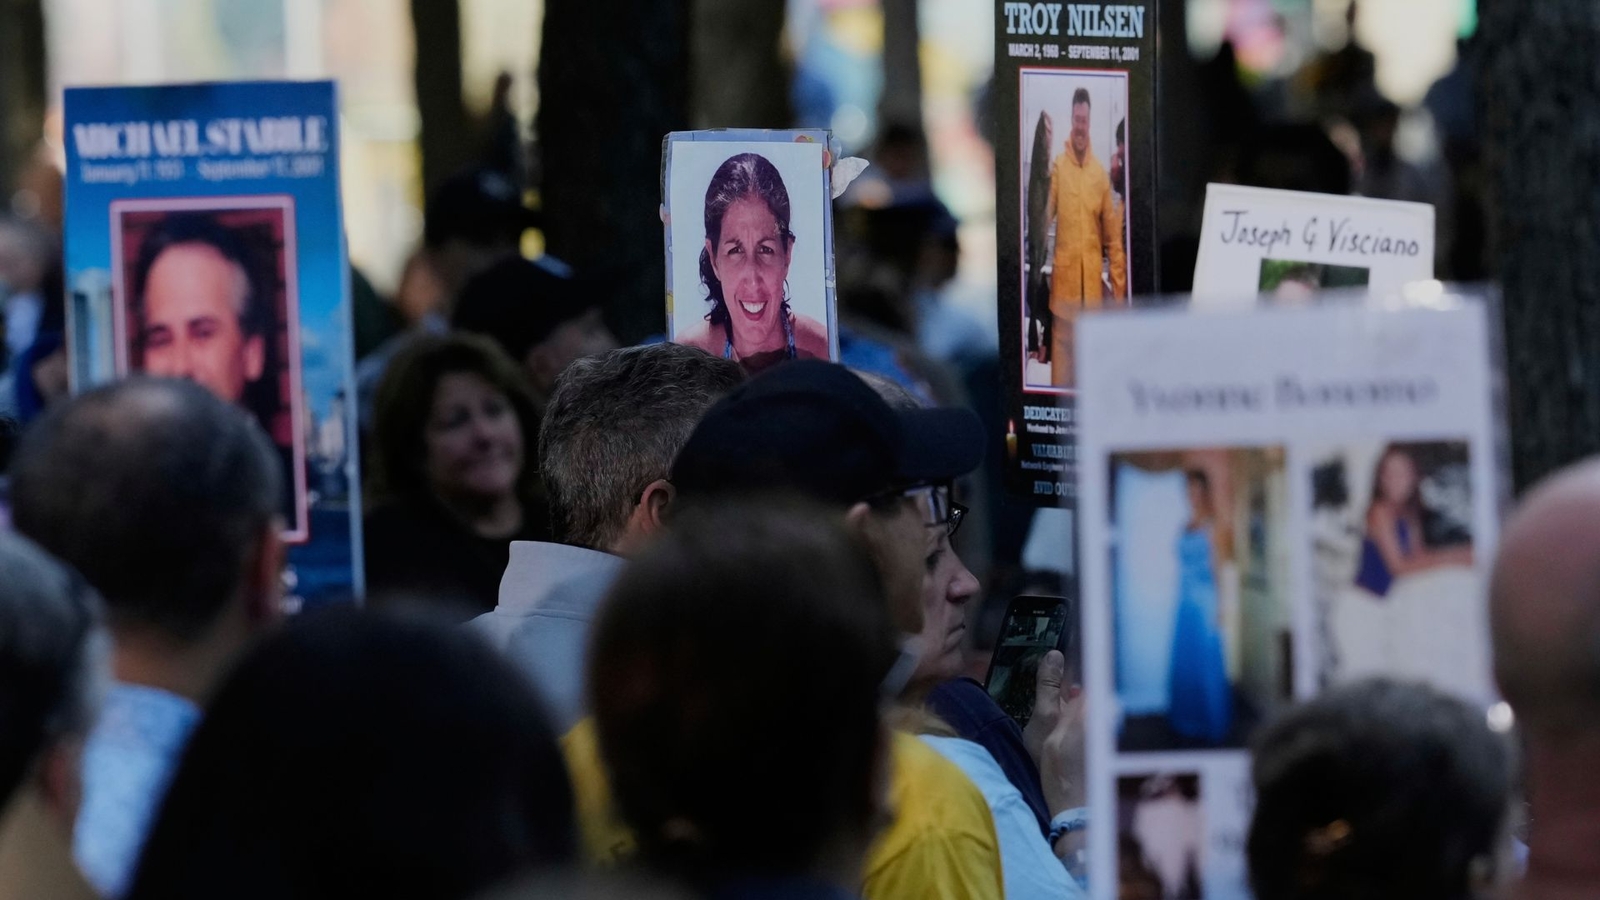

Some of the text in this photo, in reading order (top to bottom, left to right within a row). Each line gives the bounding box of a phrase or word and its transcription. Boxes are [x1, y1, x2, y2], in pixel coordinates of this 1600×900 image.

[1004, 2, 1145, 38] TROY NILSEN
[1008, 43, 1034, 58] MARCH
[1035, 44, 1042, 60] 2,
[1068, 45, 1110, 60] SEPTEMBER
[1122, 47, 1140, 61] 2001
[73, 119, 200, 159] MICHAEL
[1221, 210, 1291, 254] Joseph
[1328, 217, 1420, 256] Visciano
